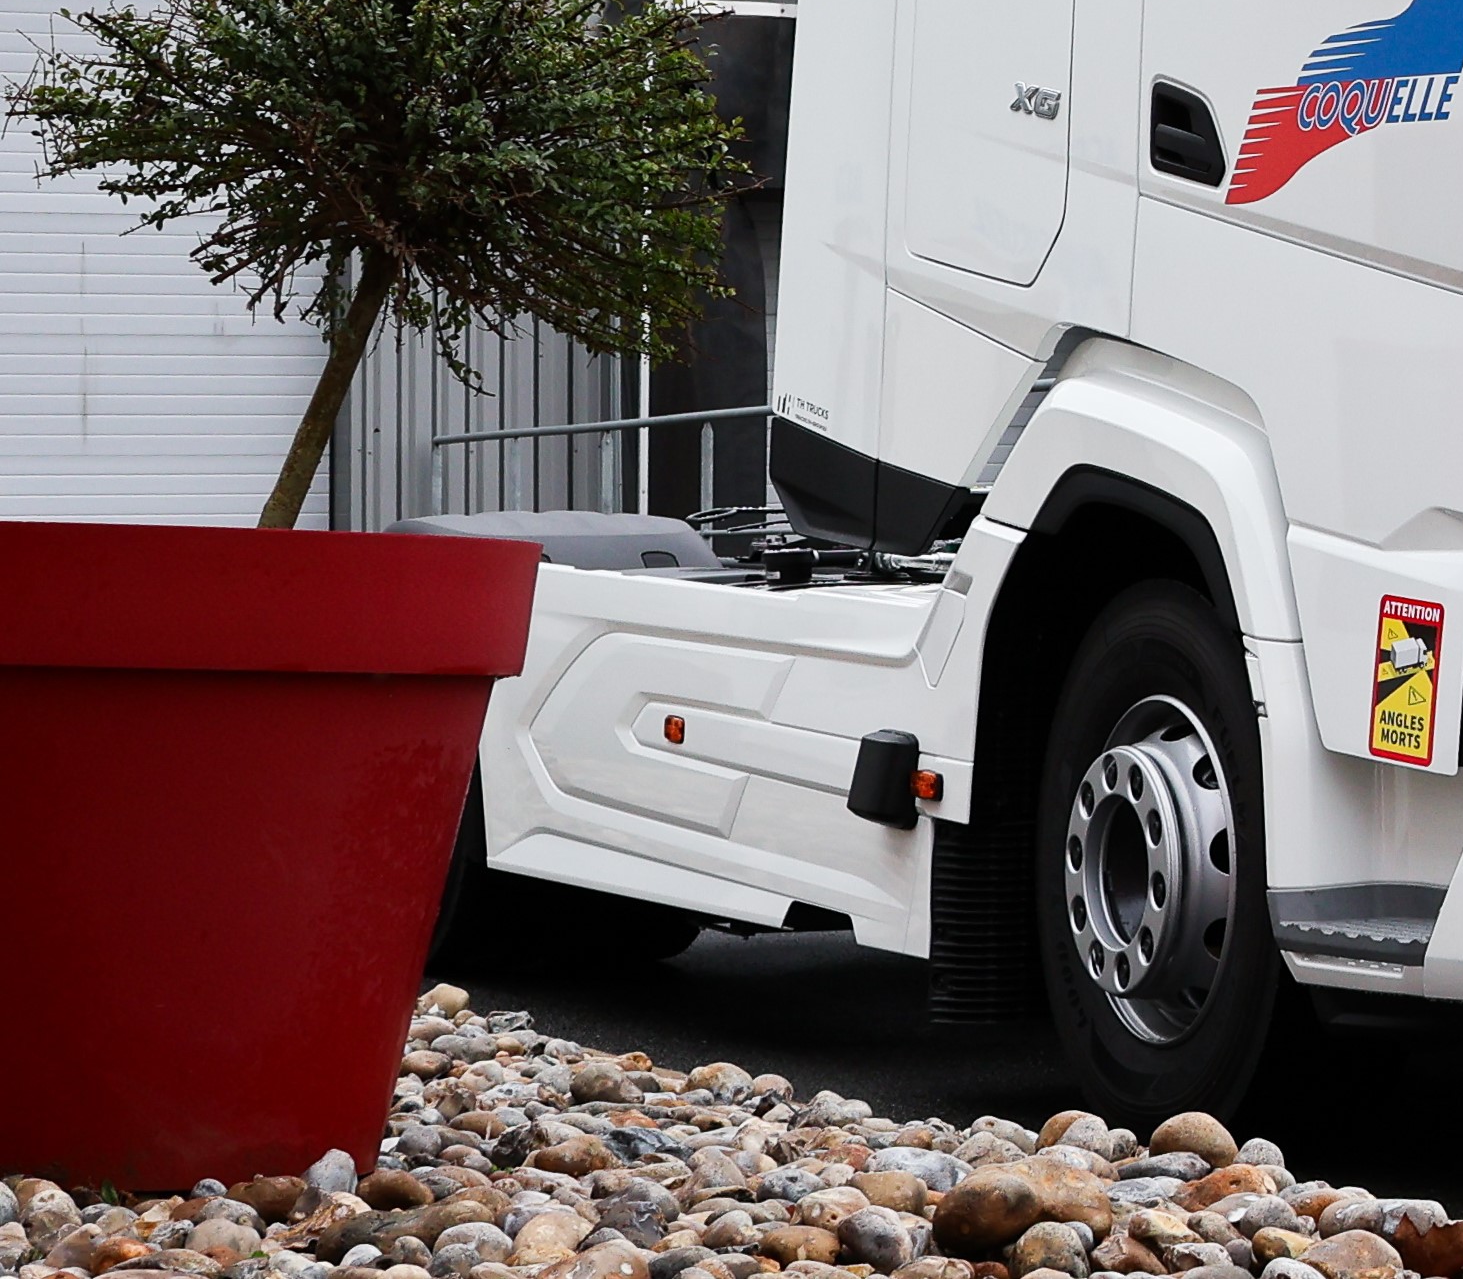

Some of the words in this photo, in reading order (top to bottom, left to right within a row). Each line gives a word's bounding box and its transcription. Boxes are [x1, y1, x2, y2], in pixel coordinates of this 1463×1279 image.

[1010, 81, 1062, 120] XG
[1298, 75, 1460, 136] COQUELLE
[1383, 600, 1441, 622] ATTENTION
[1380, 710, 1424, 732] ANGLES
[1380, 728, 1421, 749] MORTS
